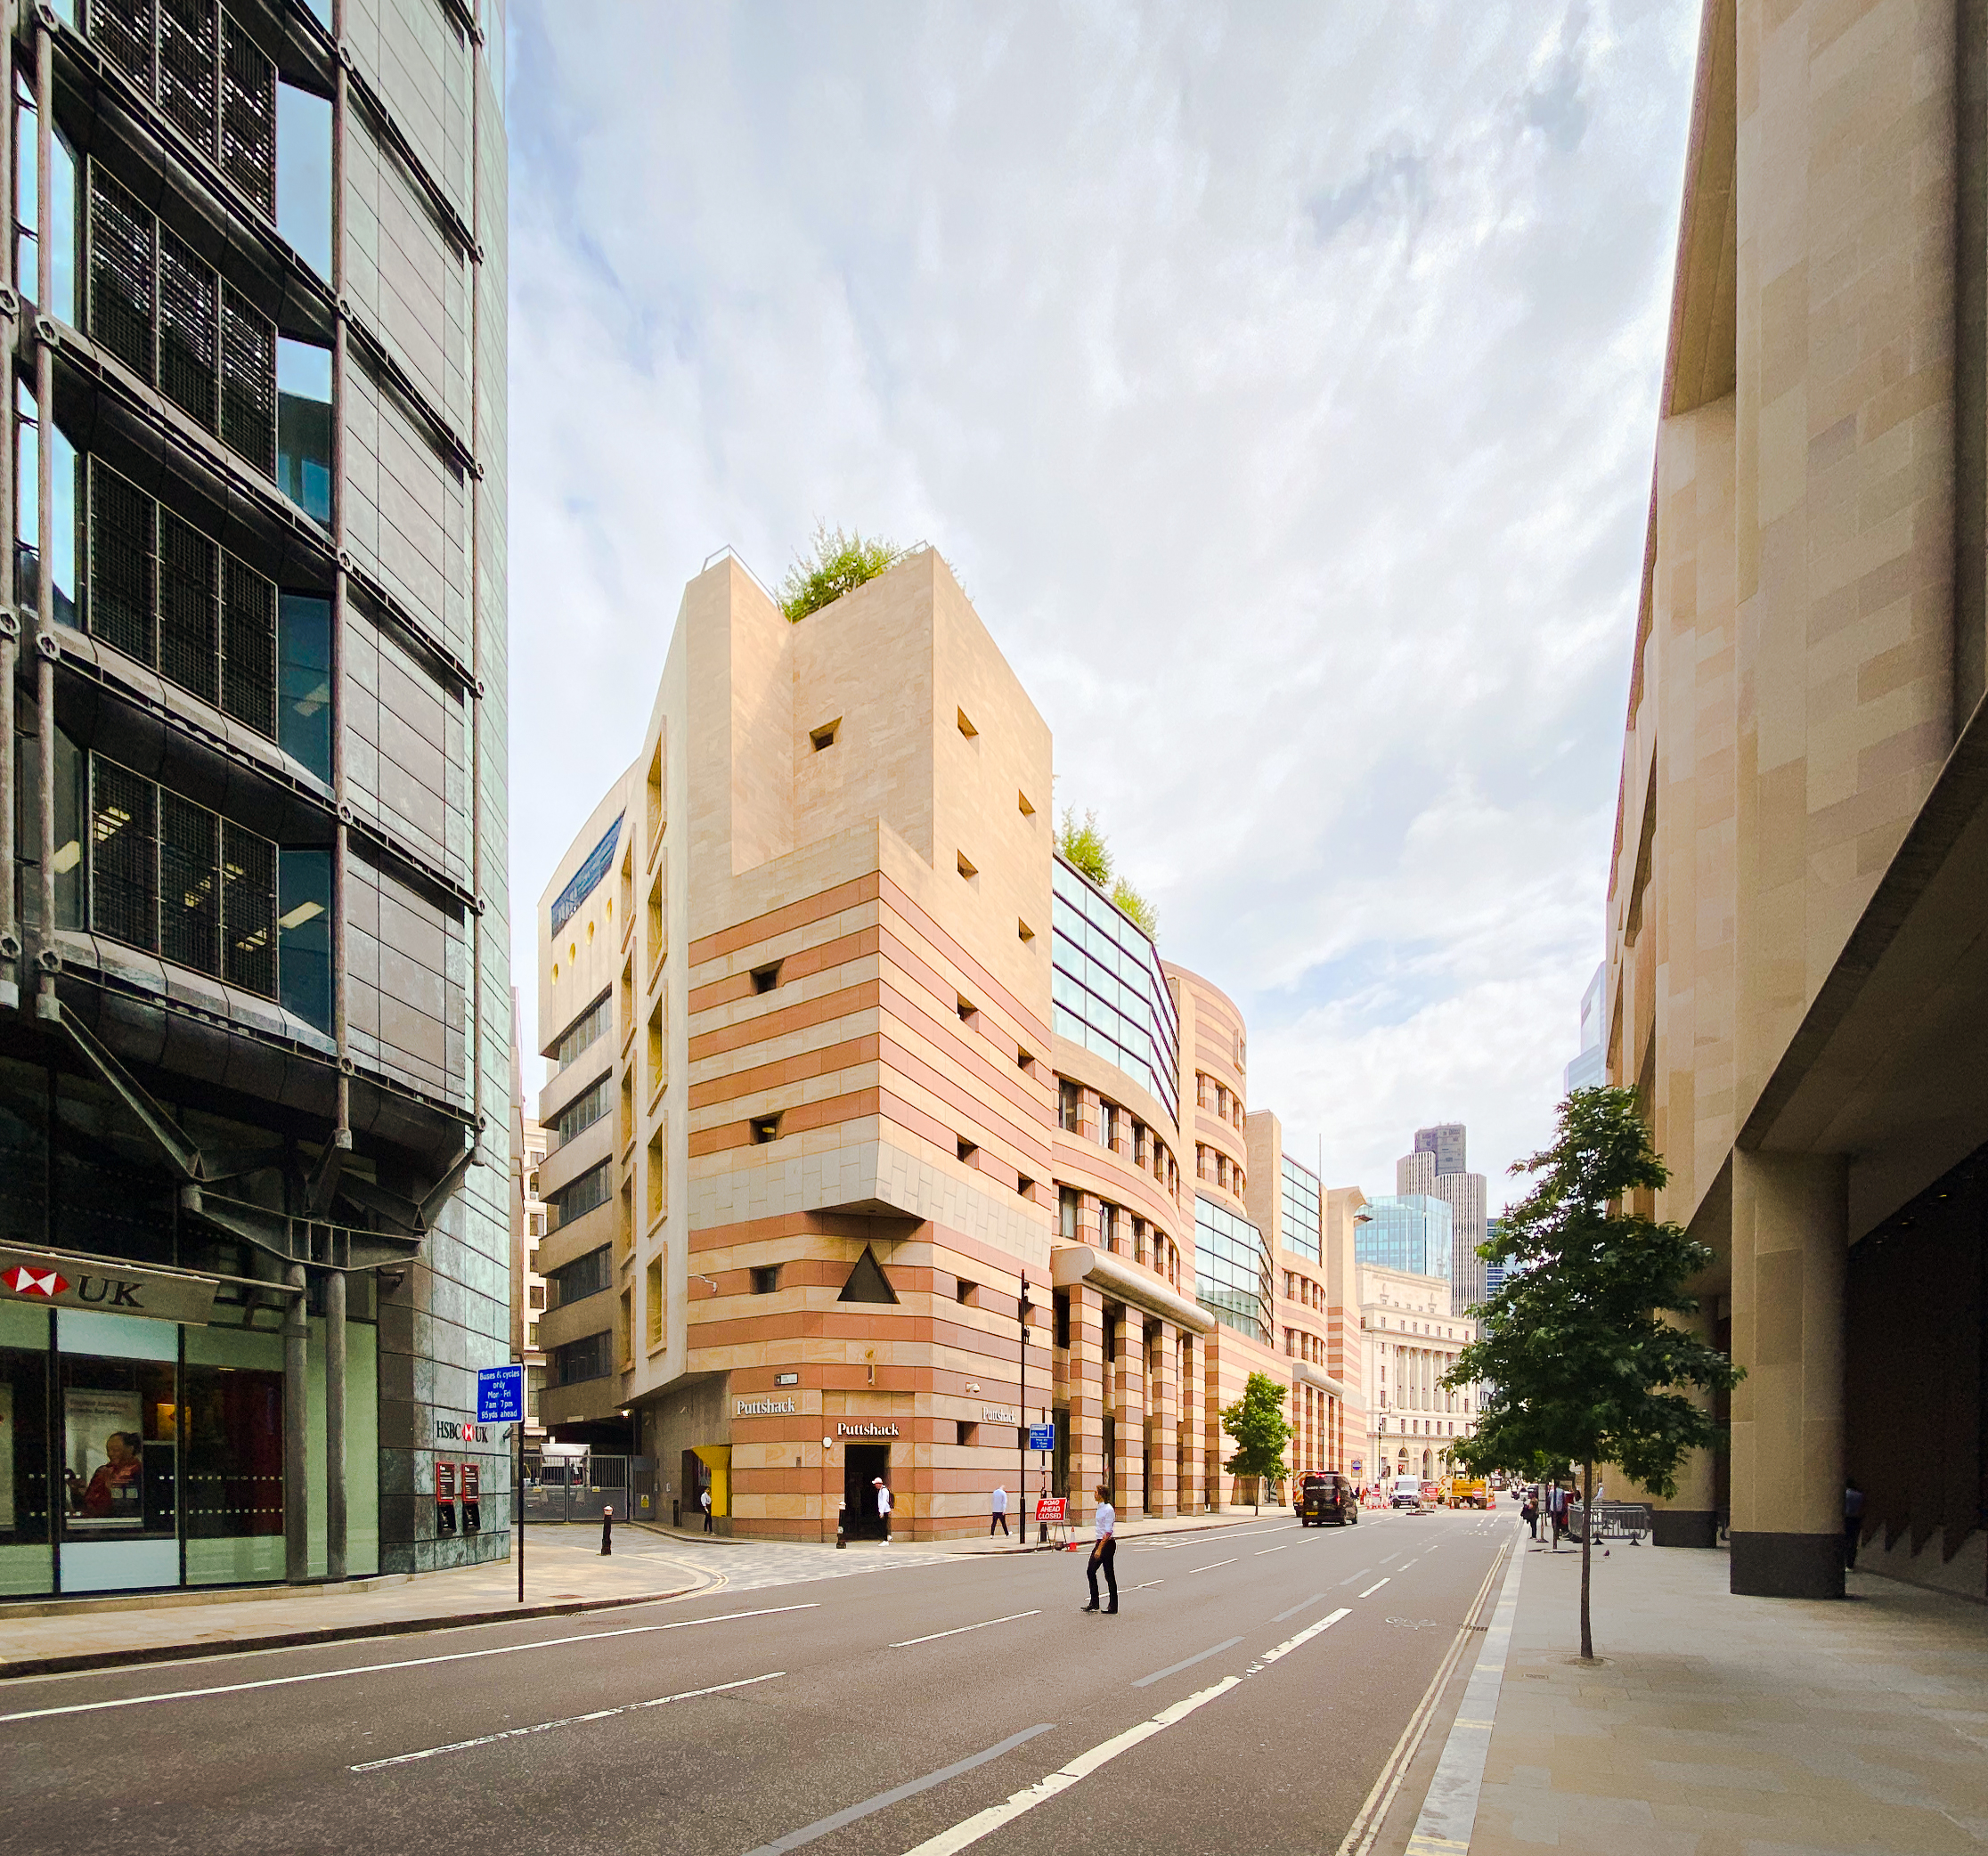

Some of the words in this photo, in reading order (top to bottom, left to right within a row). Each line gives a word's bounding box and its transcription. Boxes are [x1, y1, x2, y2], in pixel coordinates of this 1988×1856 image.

[77, 1274, 144, 1308] UK
[479, 1372, 495, 1380] Buses
[502, 1370, 520, 1380] cycles
[503, 1389, 511, 1397] Fri
[737, 1396, 795, 1415] Puttshack
[500, 1409, 517, 1418] ahead
[982, 1406, 1016, 1424] Puttshack
[436, 1420, 461, 1440] HSBC
[475, 1426, 488, 1443] UK
[837, 1422, 900, 1436] Puttshack
[1040, 1505, 1061, 1513] AHEAD
